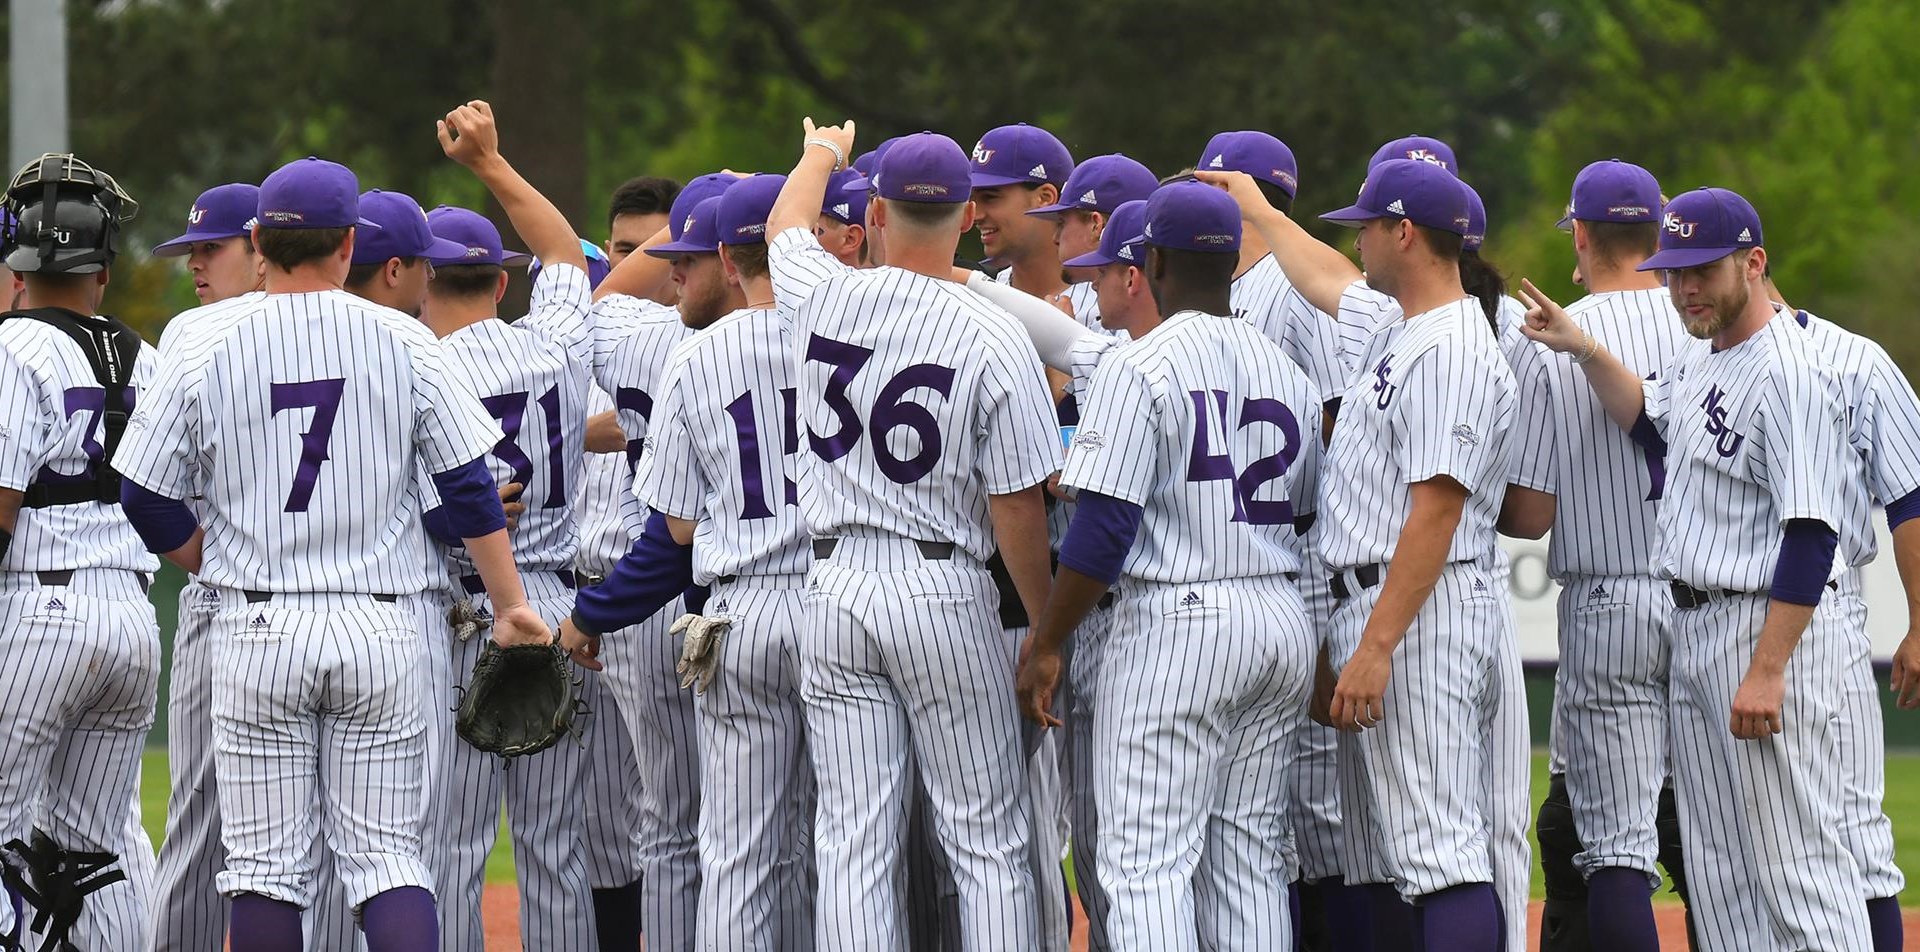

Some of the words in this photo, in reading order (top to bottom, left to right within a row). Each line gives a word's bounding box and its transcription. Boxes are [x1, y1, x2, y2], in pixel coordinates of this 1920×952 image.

[1662, 212, 1697, 239] NSU
[101, 330, 114, 363] SERIES
[109, 363, 118, 384] PRO
[1373, 353, 1397, 411] NSU
[270, 377, 346, 513] 7
[479, 382, 567, 509] 31
[805, 331, 957, 486] 36
[1700, 383, 1744, 457] NSU
[1186, 389, 1301, 526] 42
